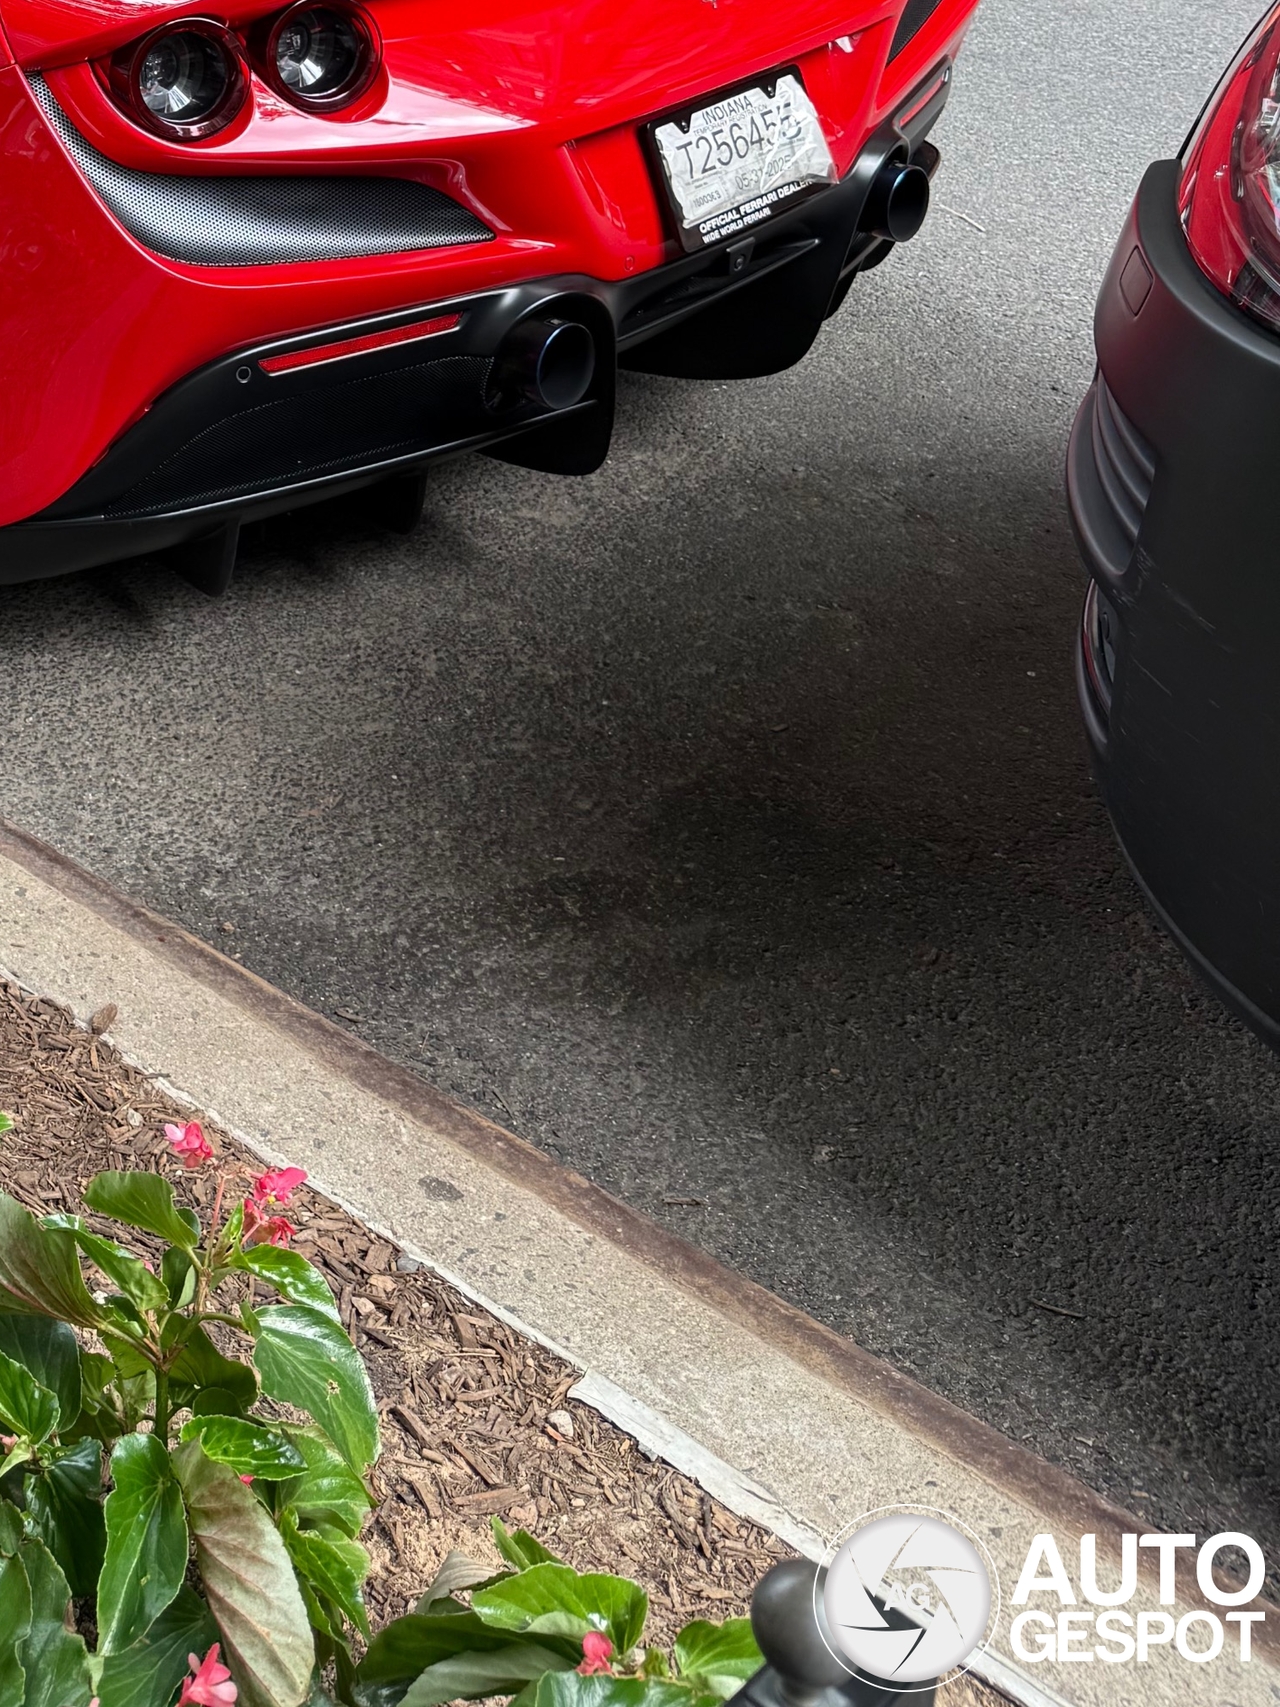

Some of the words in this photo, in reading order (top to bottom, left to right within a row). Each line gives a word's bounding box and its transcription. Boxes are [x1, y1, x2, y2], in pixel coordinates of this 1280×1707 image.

[693, 120, 728, 137] TEMPORARY
[728, 104, 768, 123] REGISTRATION
[702, 95, 753, 125] INDIANA
[699, 210, 740, 234] OFFICIAL
[740, 192, 778, 216] FERRARI
[702, 230, 721, 244] WIDE
[720, 219, 743, 237] WORLD
[743, 207, 771, 226] FERRARI
